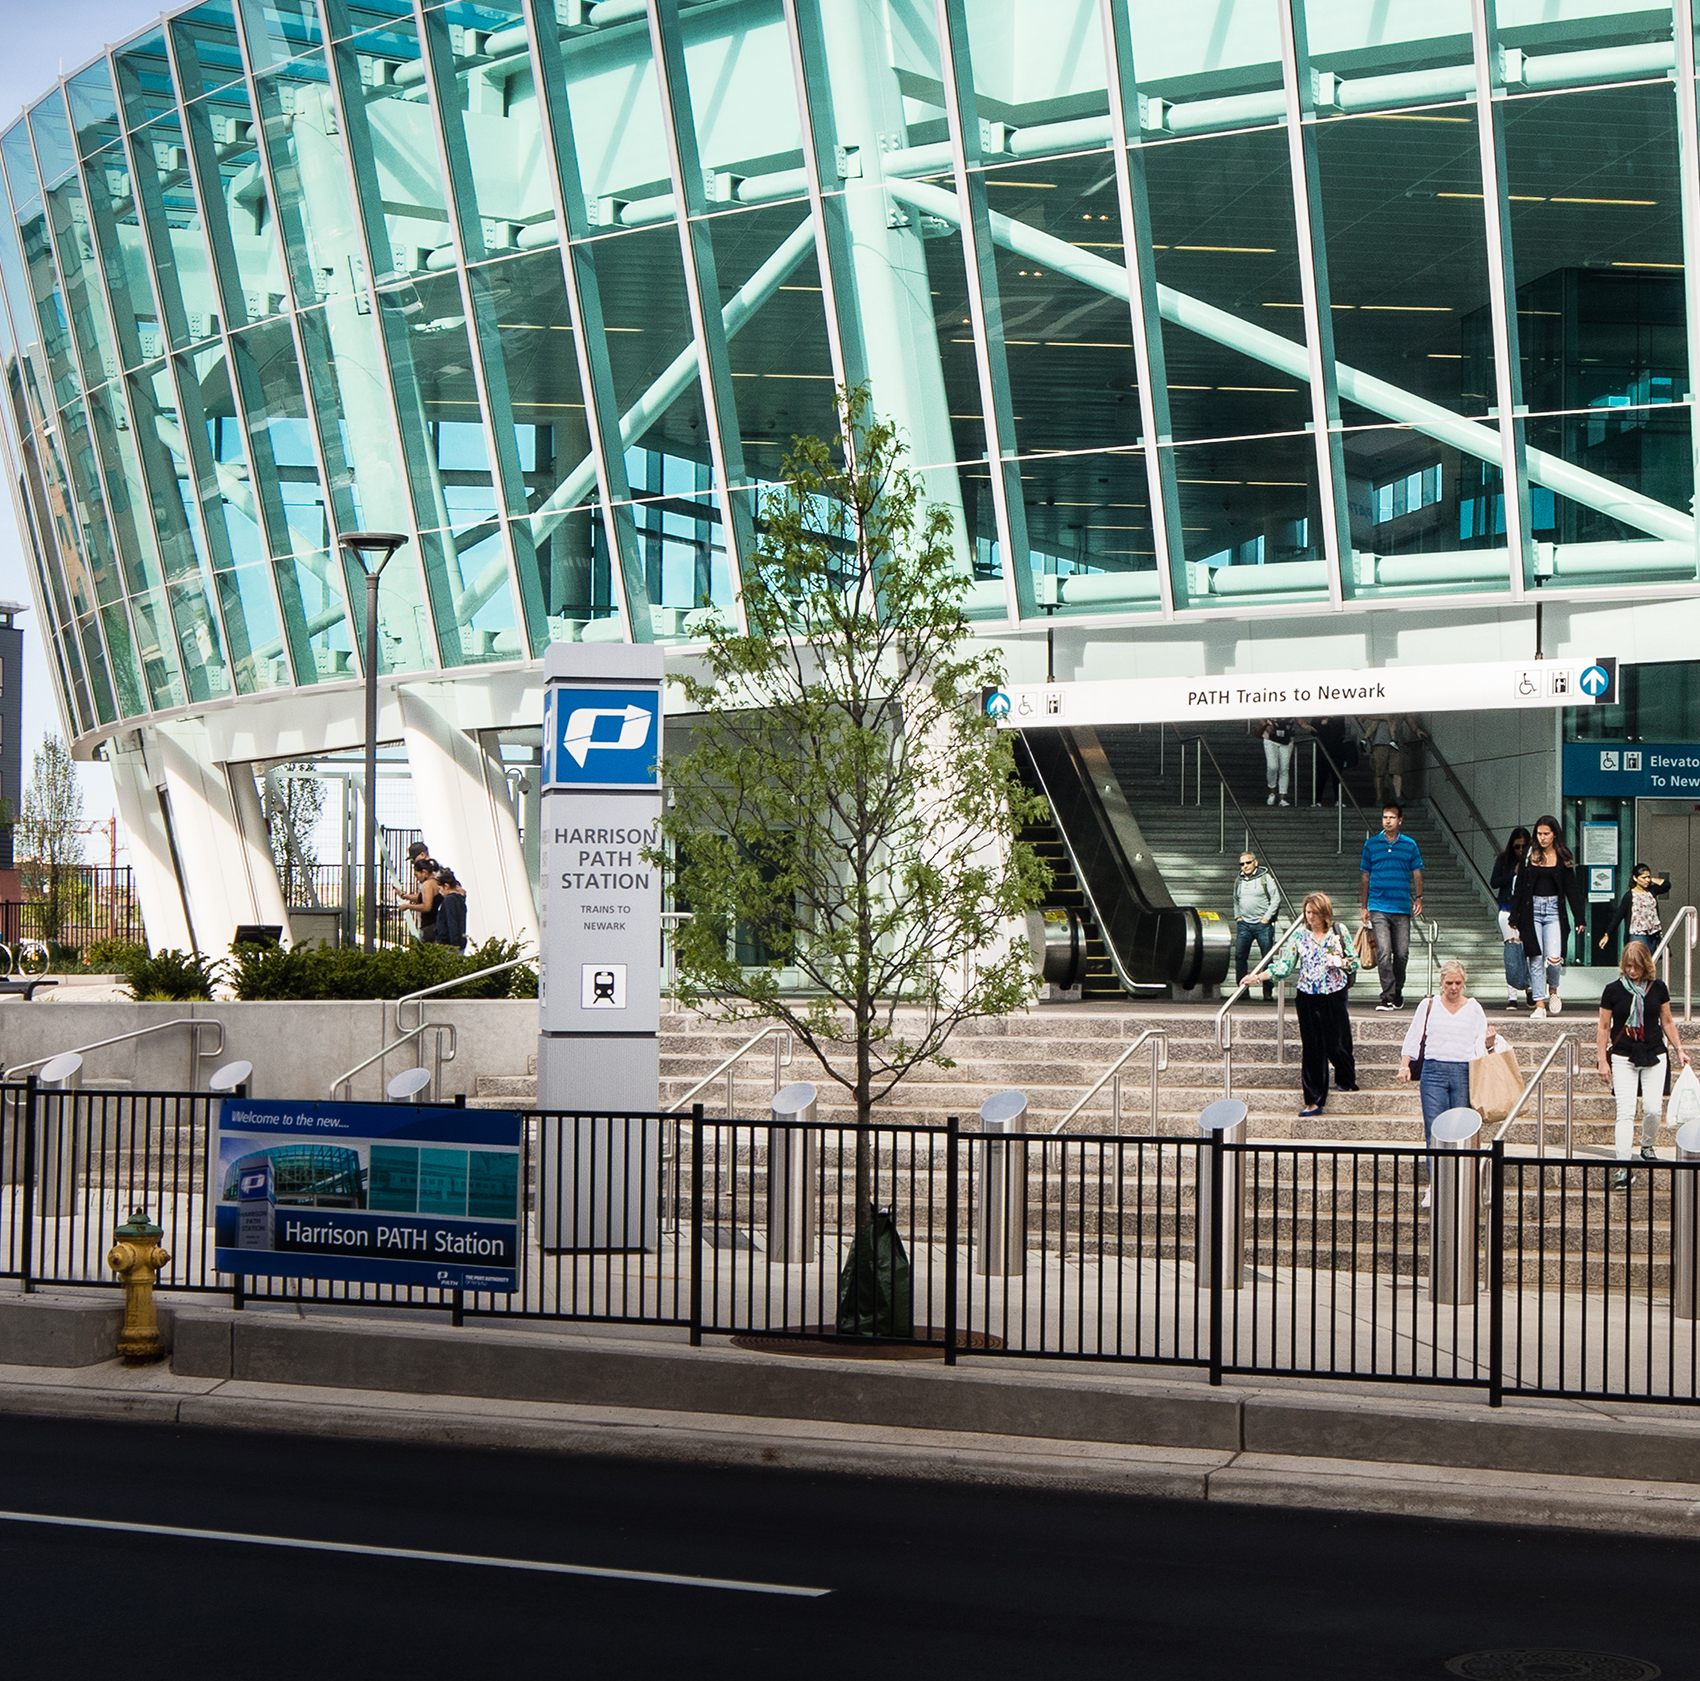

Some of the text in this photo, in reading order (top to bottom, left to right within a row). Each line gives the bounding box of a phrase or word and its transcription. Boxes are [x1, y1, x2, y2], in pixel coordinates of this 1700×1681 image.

[1188, 682, 1386, 706] PATH Trains to Newark
[1650, 775, 1666, 787] To
[554, 827, 657, 845] HARRISON
[578, 850, 632, 867] PATH
[561, 872, 649, 890] STATION
[580, 905, 631, 914] TRAINS TO
[583, 921, 626, 931] NEWARK
[231, 1110, 280, 1125] Welcome
[282, 1114, 294, 1126] to
[296, 1113, 314, 1127] the
[285, 1220, 505, 1256] Harrison PATH Station
